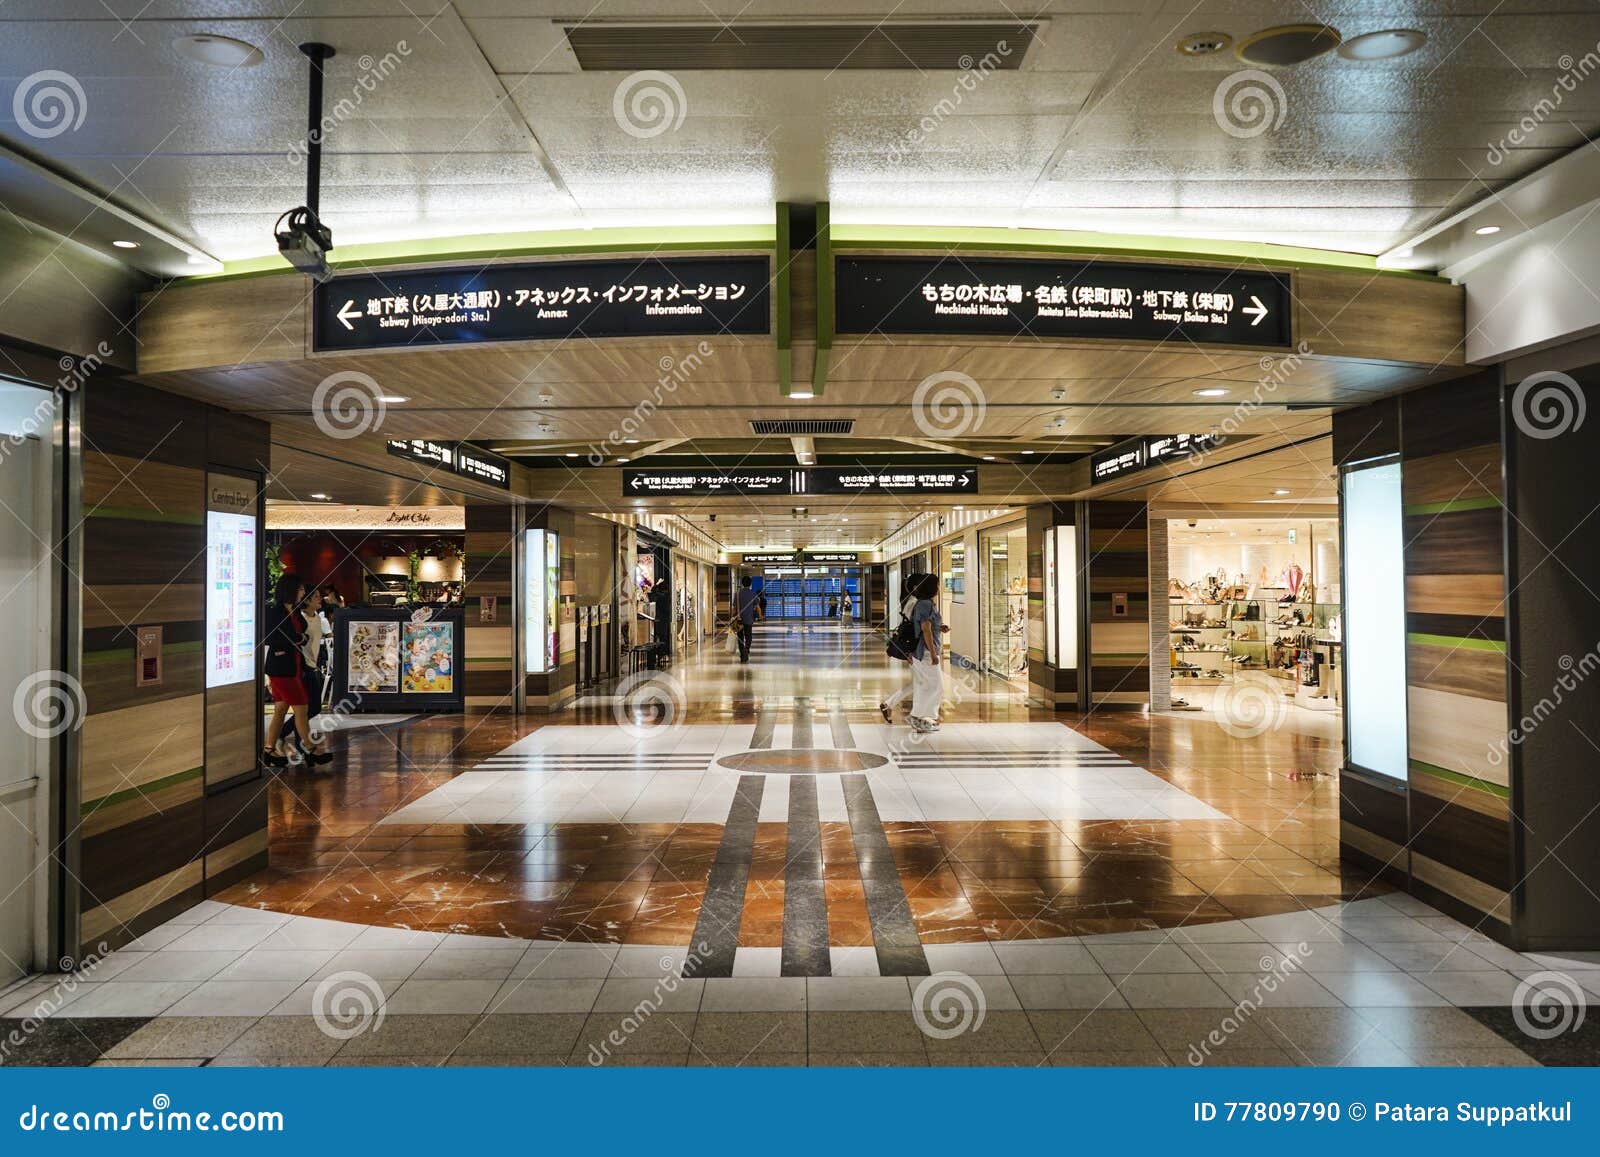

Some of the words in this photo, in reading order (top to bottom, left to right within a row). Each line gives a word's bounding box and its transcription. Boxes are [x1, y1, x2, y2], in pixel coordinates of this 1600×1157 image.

[380, 316, 409, 328] Subway
[412, 312, 468, 327] (Hisaya-odori
[471, 310, 490, 322] Sta.)
[537, 307, 568, 319] Annex
[645, 303, 702, 315] Information
[935, 303, 978, 315] Mochinoki
[979, 304, 1009, 316] Hiroba
[1153, 309, 1182, 324] Subway
